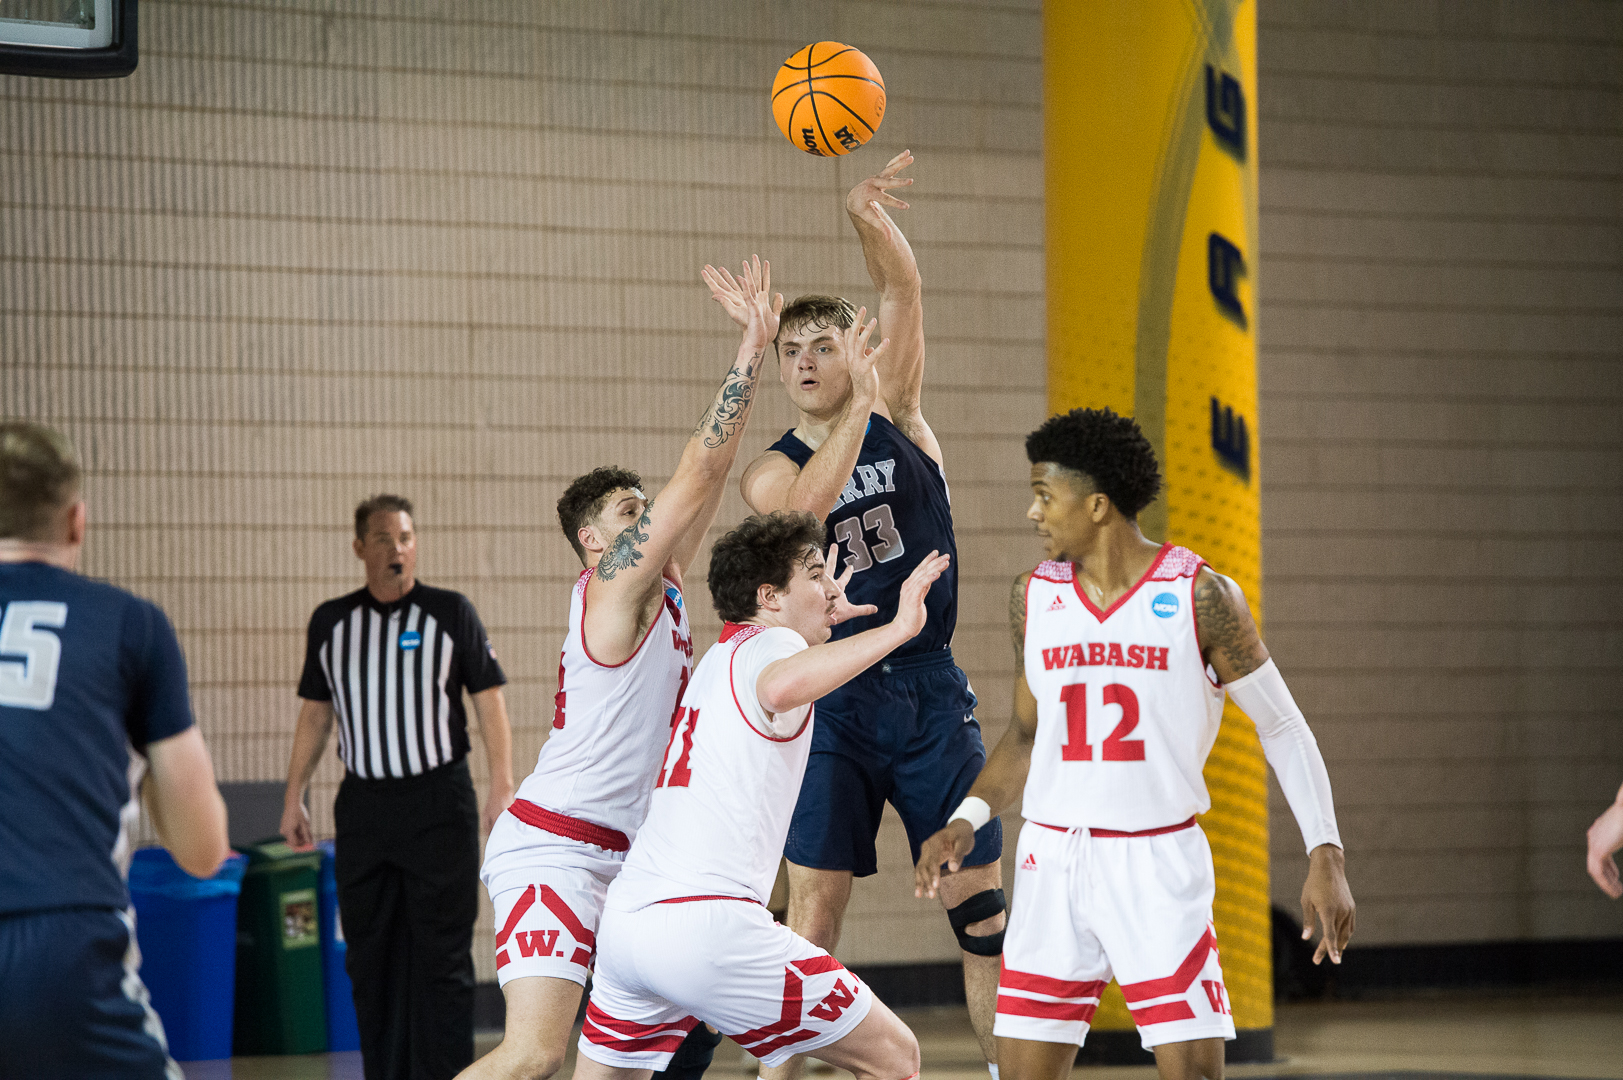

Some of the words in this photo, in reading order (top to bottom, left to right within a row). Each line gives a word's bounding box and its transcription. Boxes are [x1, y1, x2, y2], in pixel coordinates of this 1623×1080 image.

[830, 458, 896, 514] RRY
[834, 504, 905, 573] 33
[0, 600, 68, 711] 5
[1042, 642, 1169, 671] WABASH
[1059, 683, 1146, 762] 12
